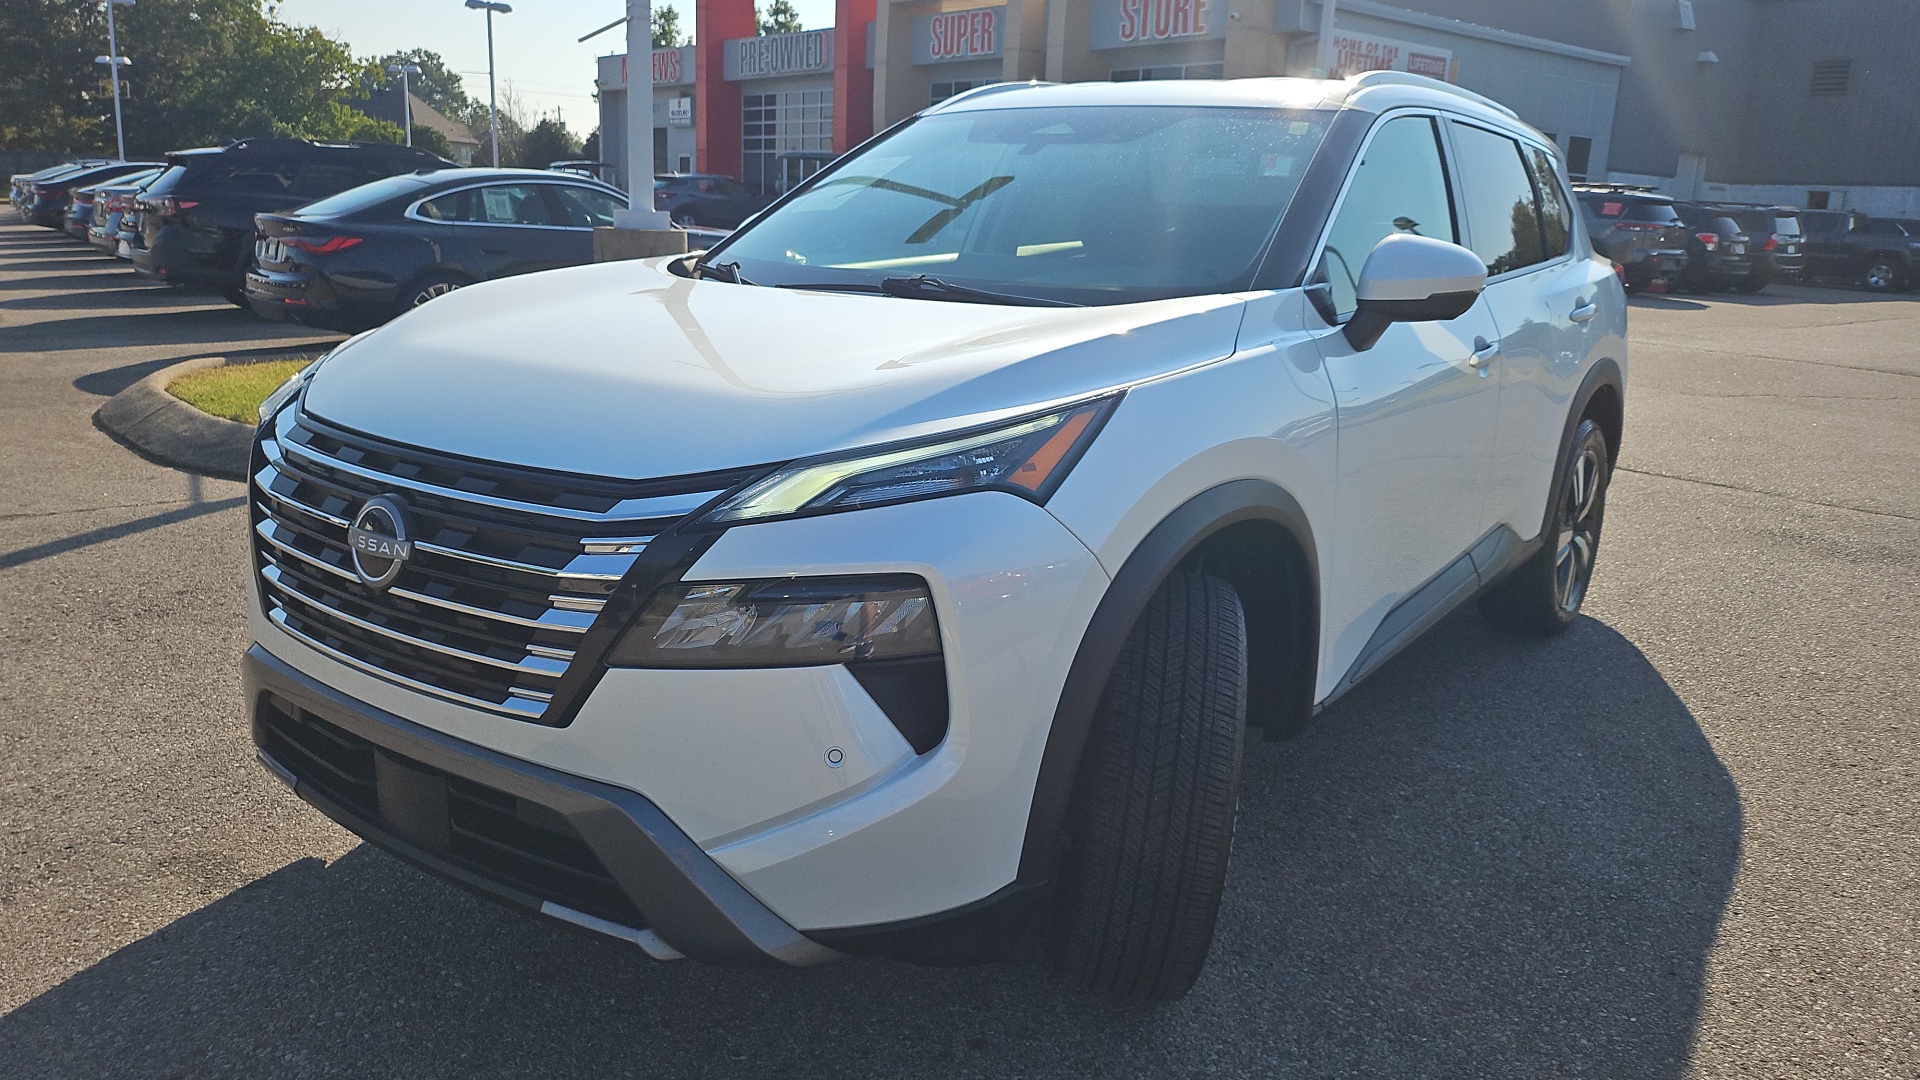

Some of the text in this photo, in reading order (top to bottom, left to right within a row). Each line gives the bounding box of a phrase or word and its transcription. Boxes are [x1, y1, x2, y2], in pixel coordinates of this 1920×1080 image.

[740, 32, 826, 75] PRE-OWNED
[930, 9, 994, 59] SUPER
[1333, 36, 1399, 59] HOME OF THE
